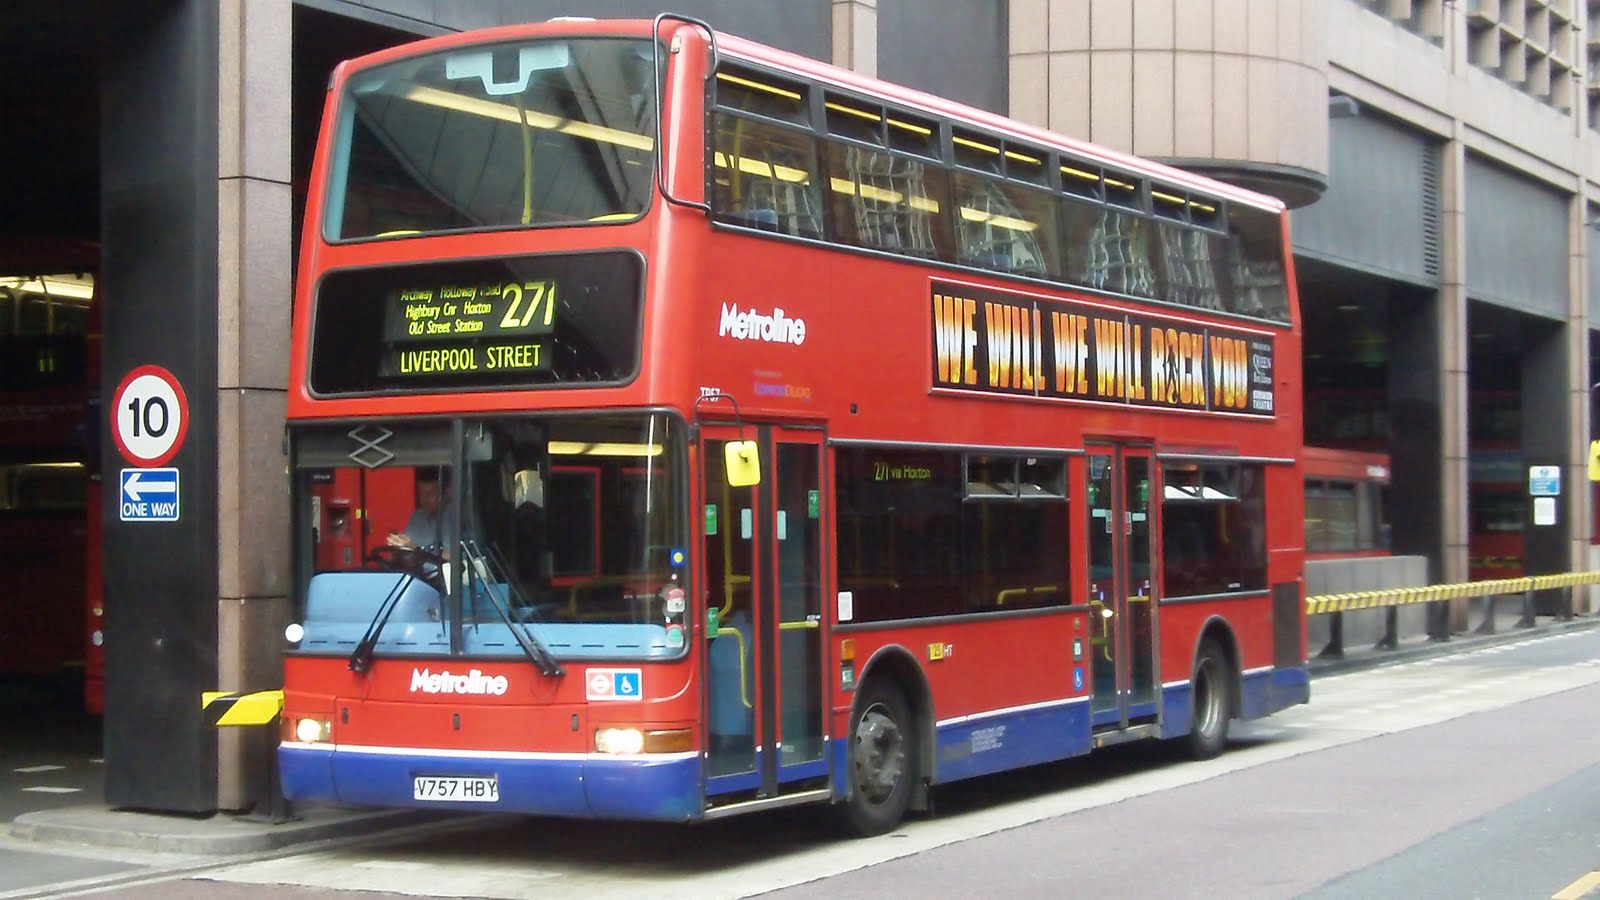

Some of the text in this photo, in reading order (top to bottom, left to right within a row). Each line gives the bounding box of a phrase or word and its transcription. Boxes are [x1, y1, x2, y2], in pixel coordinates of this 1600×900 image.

[405, 304, 441, 321] Highbury
[464, 301, 492, 315] Hoxton
[500, 281, 555, 328] 271
[409, 318, 483, 335] Old Street Station
[719, 301, 806, 346] Metroline
[400, 344, 542, 374] LIVERPOOL STREET
[934, 294, 1248, 409] WE WILL WE WILL ROCK YOU
[128, 396, 169, 438] 10
[123, 502, 177, 517] ONE WAY
[410, 667, 509, 696] Metroline
[417, 780, 496, 797] V757 HBY
